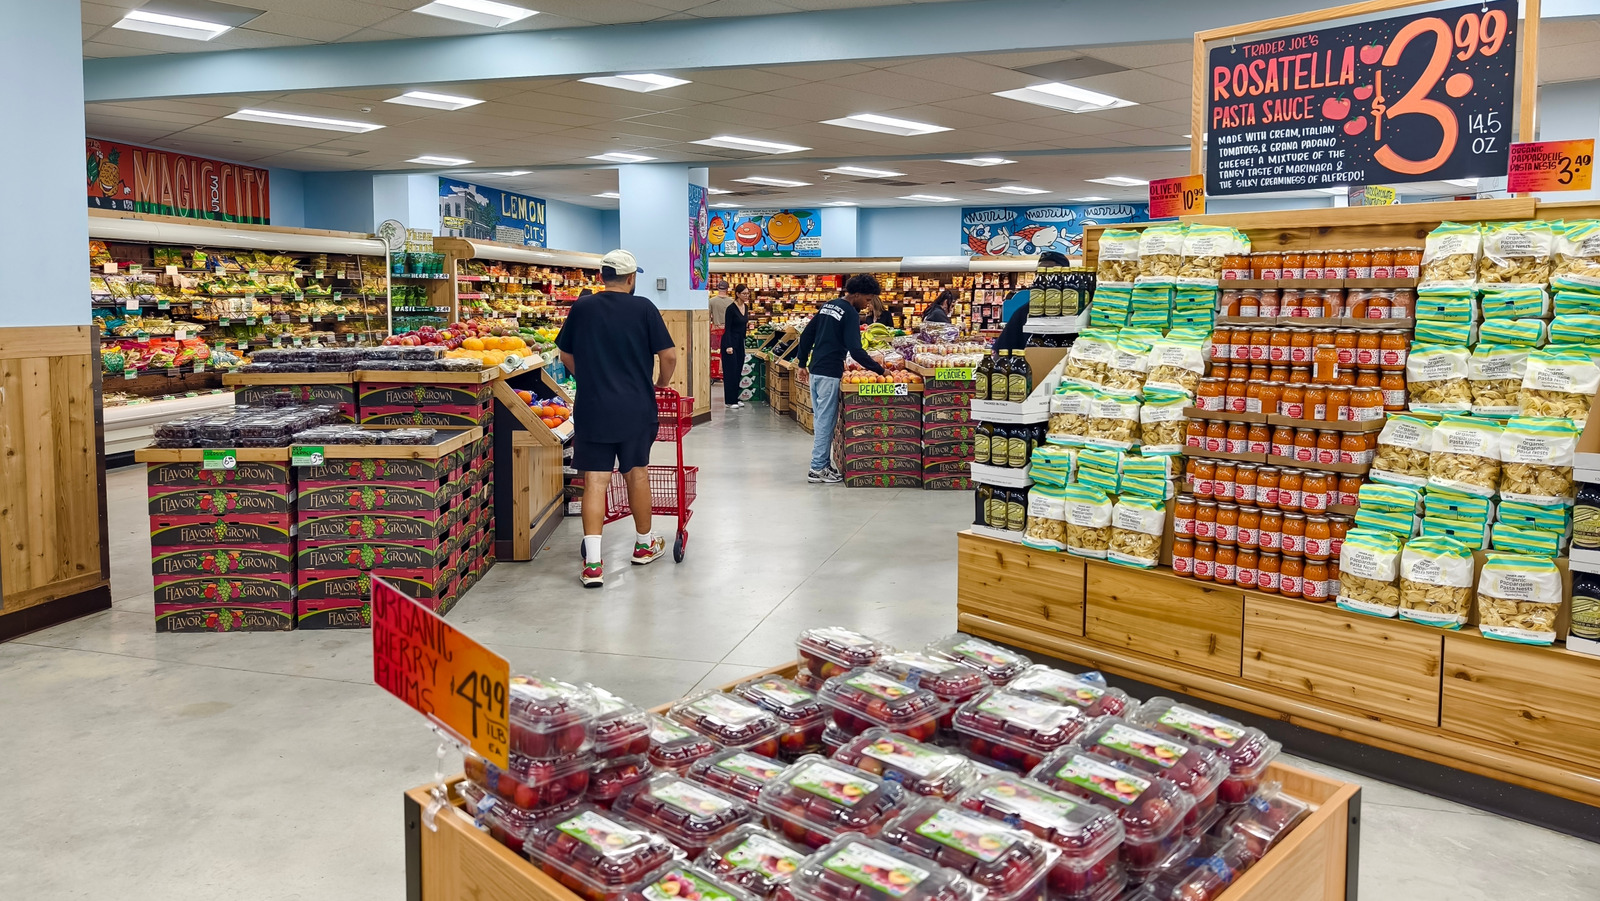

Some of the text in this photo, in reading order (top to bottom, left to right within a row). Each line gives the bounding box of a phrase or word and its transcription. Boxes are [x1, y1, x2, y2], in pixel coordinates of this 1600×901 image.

[1242, 34, 1319, 58] TRADER JOE'S
[1213, 46, 1355, 101] ROSATELLA
[1213, 95, 1315, 129] PASTA SAUCE
[1468, 111, 1502, 134] 14.5
[1218, 125, 1335, 145] MADE WITH CREAM, ITALIAN
[1270, 141, 1298, 152] GRANA
[1301, 138, 1337, 149] PADANO
[1471, 137, 1498, 154] OZ
[1511, 146, 1544, 154] ORGANIC
[1219, 149, 1346, 169] CHEESE! A MIXTURE OF THE
[1511, 152, 1563, 163] PAPPARDELLE
[1219, 161, 1343, 179] TANGY TASTE OF MARINARA &
[1510, 161, 1557, 172] PASTA NESTS
[132, 149, 267, 225] MAGIC CITY
[1219, 170, 1365, 190] THE SILKY CREAMINESS OF ALFREDO!
[1150, 182, 1182, 195] OLIVE OIL
[501, 193, 545, 225] LEMON
[964, 208, 1017, 232] merrily
[1025, 207, 1076, 227] merrily
[524, 224, 545, 242] CITY
[937, 370, 967, 380] PEACHES
[312, 389, 344, 401] GROWN
[386, 390, 453, 402] FLAVOR GROWN
[160, 467, 275, 482] FLAVOR GROWN
[310, 463, 423, 477] FLAVOR GROWN
[160, 497, 276, 512] FLAVOR GROWN
[310, 493, 423, 508] FLAVOR GROWN
[181, 527, 260, 541] FLAVOR GROWN
[310, 522, 422, 537] FLAVOR GROWN
[163, 556, 277, 573] FLAVOR GROWN
[310, 551, 422, 566] FLAVOR GROWN
[165, 585, 279, 600] FLAVOR GROWN
[325, 581, 357, 595] FLAVOR
[167, 614, 280, 631] FLAVOR GROWN
[328, 611, 360, 625] FLAVOR
[374, 583, 453, 662] ORGANIC
[373, 620, 438, 687] CHERRY
[376, 655, 435, 715] PLUMS
